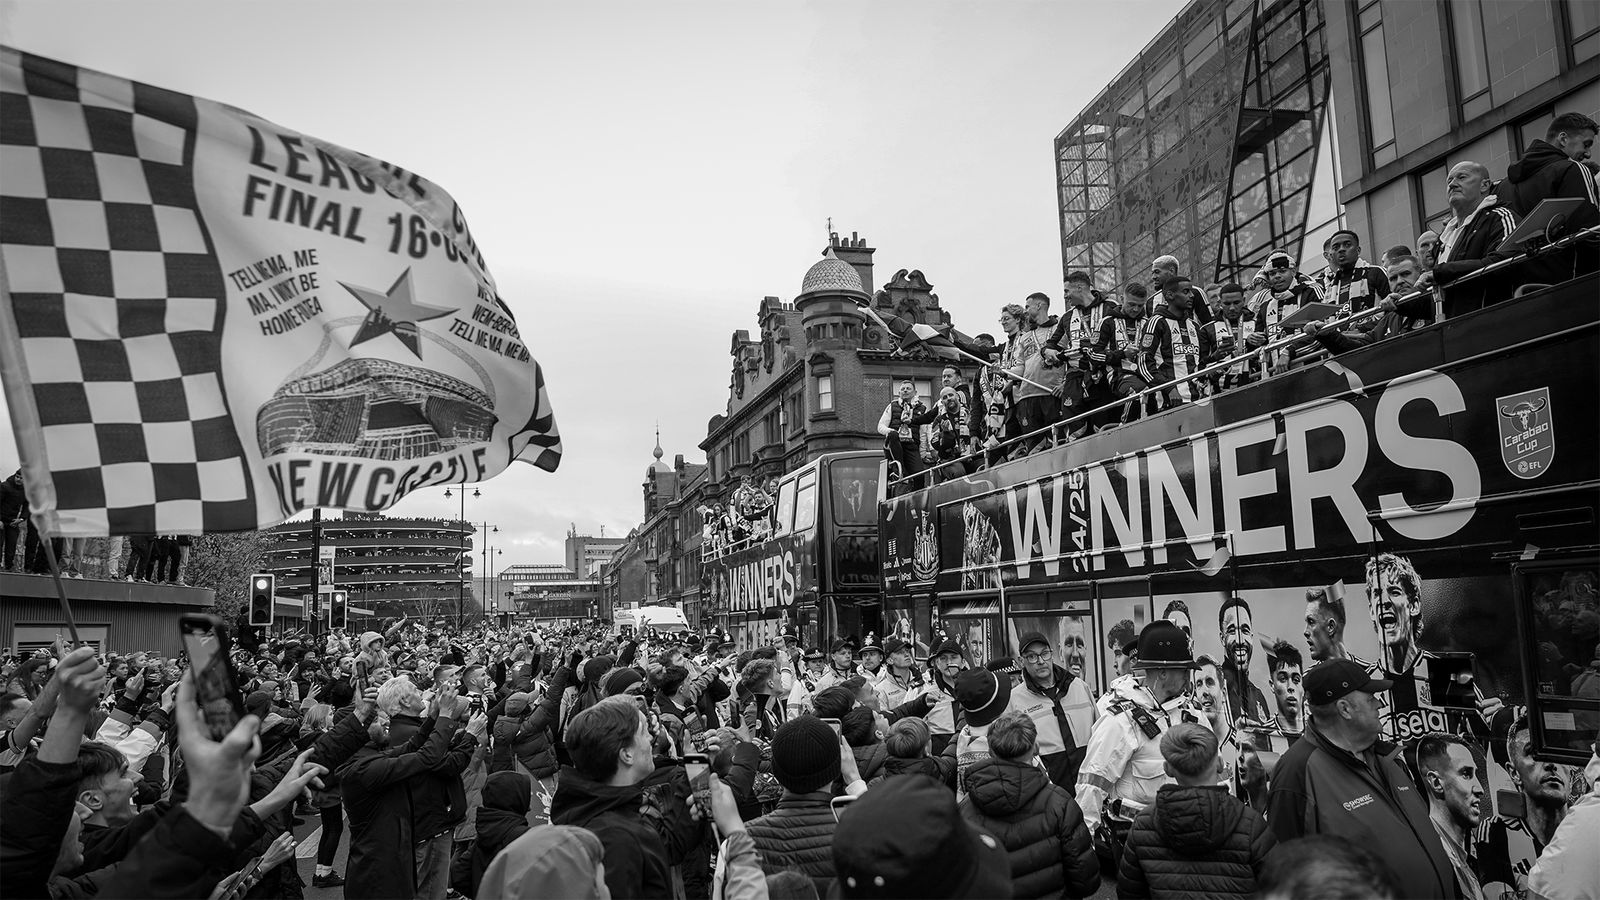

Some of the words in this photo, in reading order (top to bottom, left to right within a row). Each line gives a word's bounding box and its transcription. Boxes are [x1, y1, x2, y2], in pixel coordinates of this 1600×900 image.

[242, 173, 366, 243] FINAL
[228, 266, 262, 291] TELL
[294, 248, 319, 268] ME
[299, 272, 319, 292] BE
[259, 308, 301, 336] HOME
[449, 317, 475, 343] TELL
[475, 329, 488, 349] ME
[504, 341, 521, 359] ME
[1504, 422, 1549, 448] Carabao
[1517, 439, 1538, 454] Cup
[1529, 461, 1542, 470] EFL
[1068, 467, 1089, 574] 24/25
[1398, 709, 1445, 737] sela
